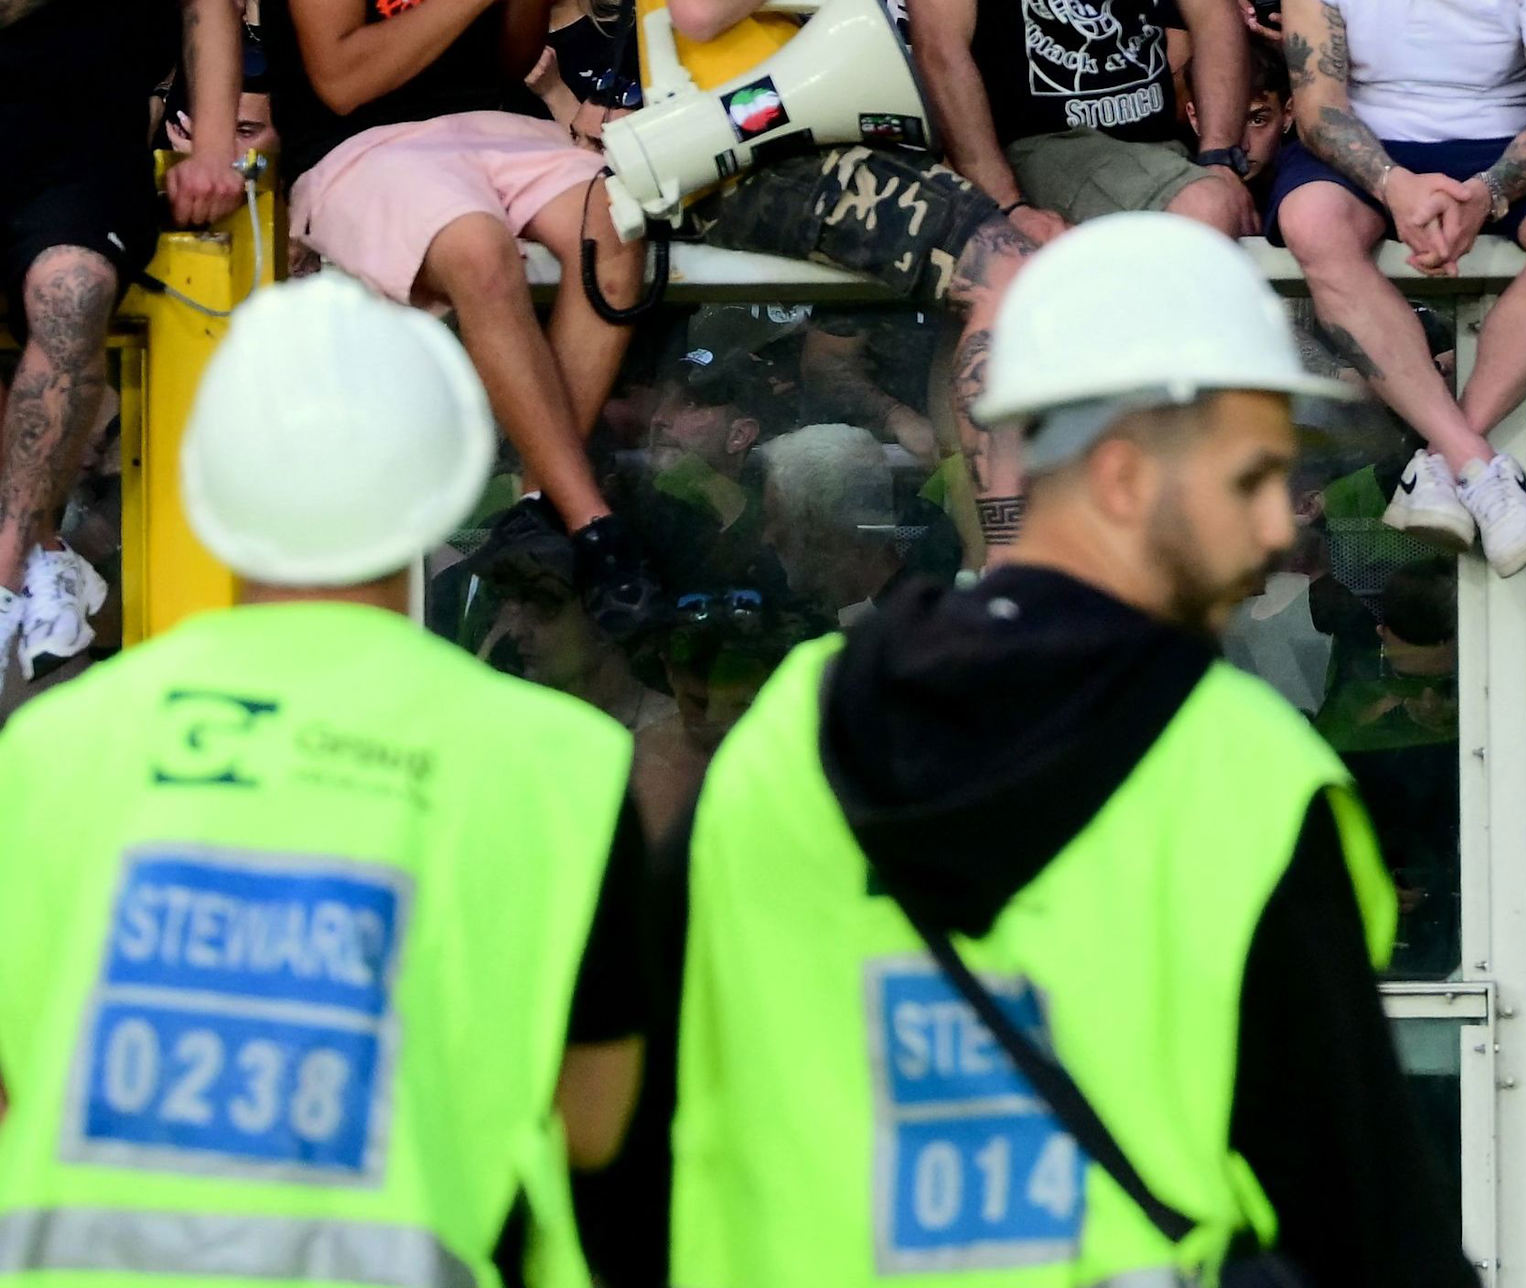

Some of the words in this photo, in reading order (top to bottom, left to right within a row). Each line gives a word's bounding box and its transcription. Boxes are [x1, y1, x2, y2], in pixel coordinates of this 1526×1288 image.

[1064, 82, 1164, 130] STORICO
[115, 885, 385, 987] STEWARD
[101, 1015, 351, 1144] 0238
